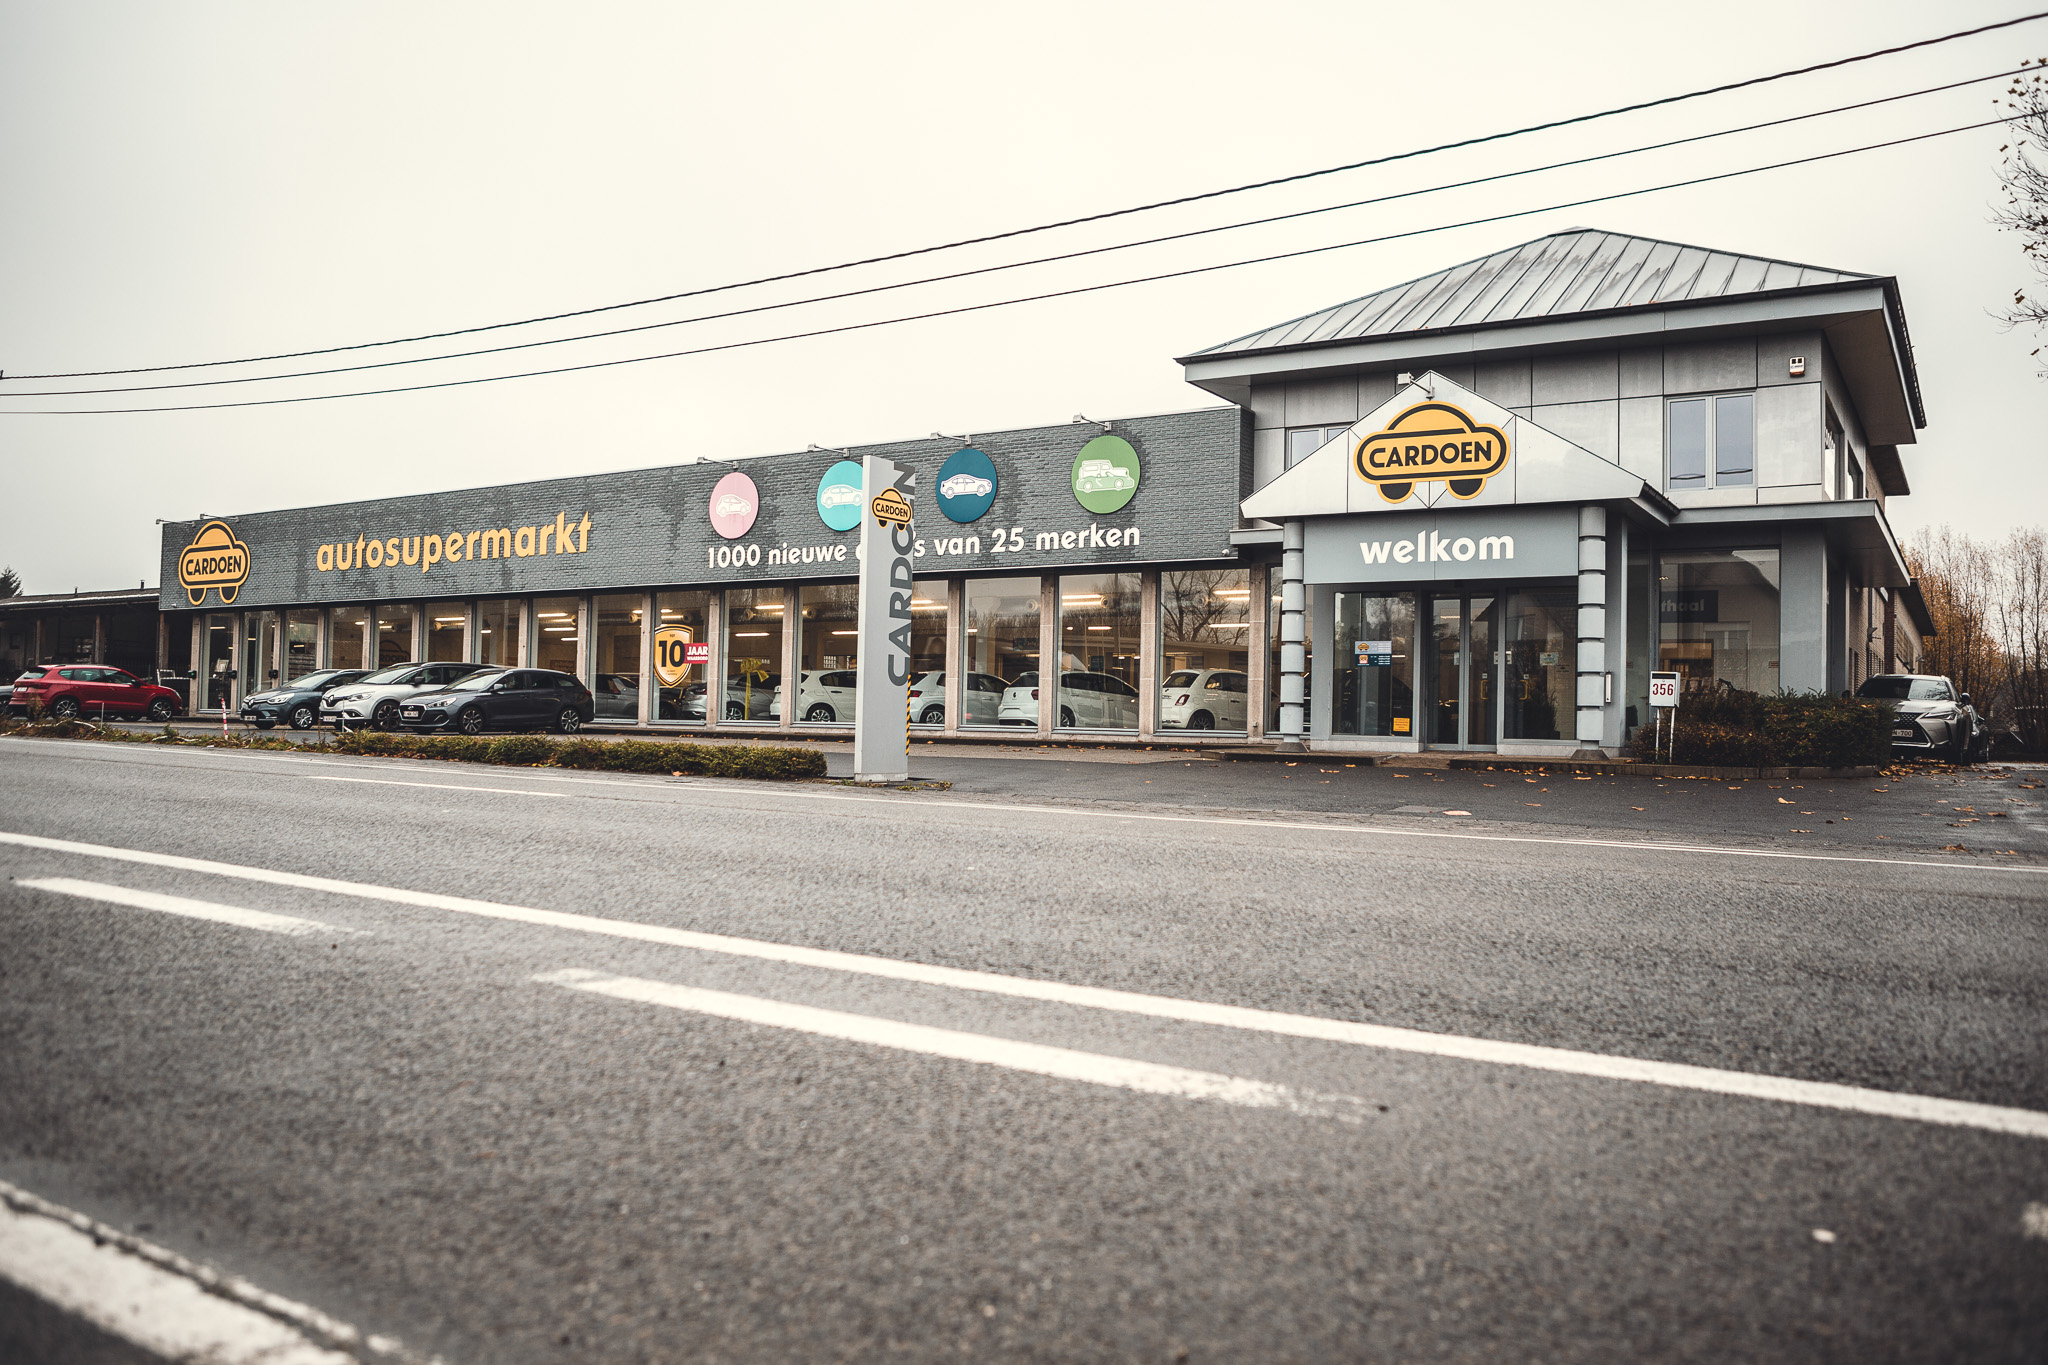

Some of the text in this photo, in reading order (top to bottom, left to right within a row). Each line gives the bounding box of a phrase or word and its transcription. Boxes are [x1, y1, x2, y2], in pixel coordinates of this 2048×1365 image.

[1369, 440, 1492, 469] CARDOEN
[875, 503, 909, 518] CARDOEN
[316, 511, 593, 573] autosupermarkt
[708, 544, 761, 568] 1000
[768, 542, 848, 565] nieuwe
[934, 536, 980, 556] van
[990, 527, 1025, 553] 25
[1035, 522, 1141, 550] merken
[1360, 529, 1514, 565] welkom
[186, 554, 242, 576] CARDOEN
[658, 639, 686, 668] 10
[686, 646, 709, 655] JAAR
[1652, 683, 1674, 696] 356
